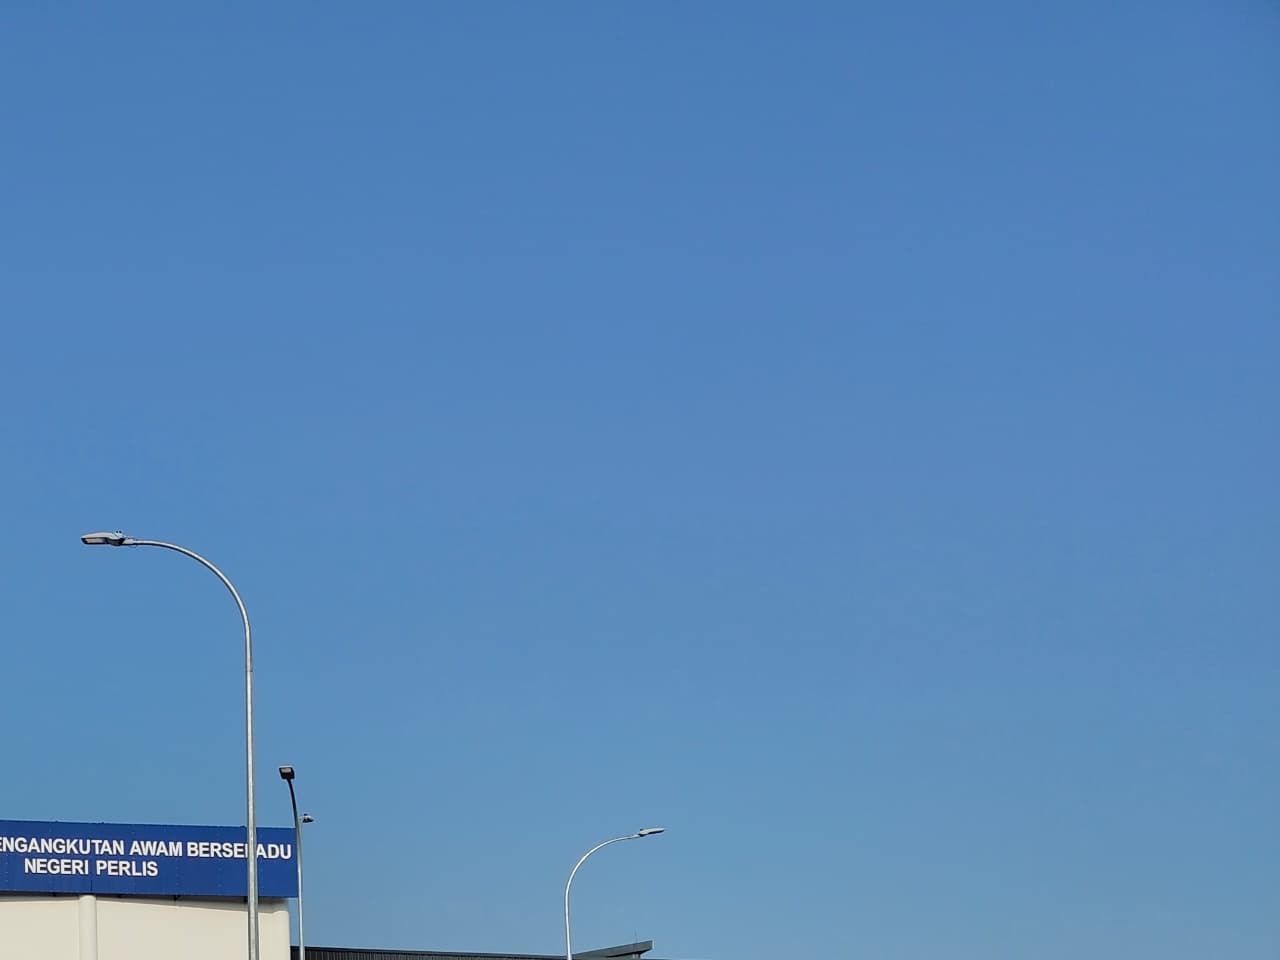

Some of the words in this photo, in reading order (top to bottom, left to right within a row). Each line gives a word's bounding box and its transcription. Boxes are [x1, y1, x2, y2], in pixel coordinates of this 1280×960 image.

[129, 840, 183, 857] AWAM
[24, 858, 89, 875] NEGERI
[96, 860, 159, 877] PERLIS
